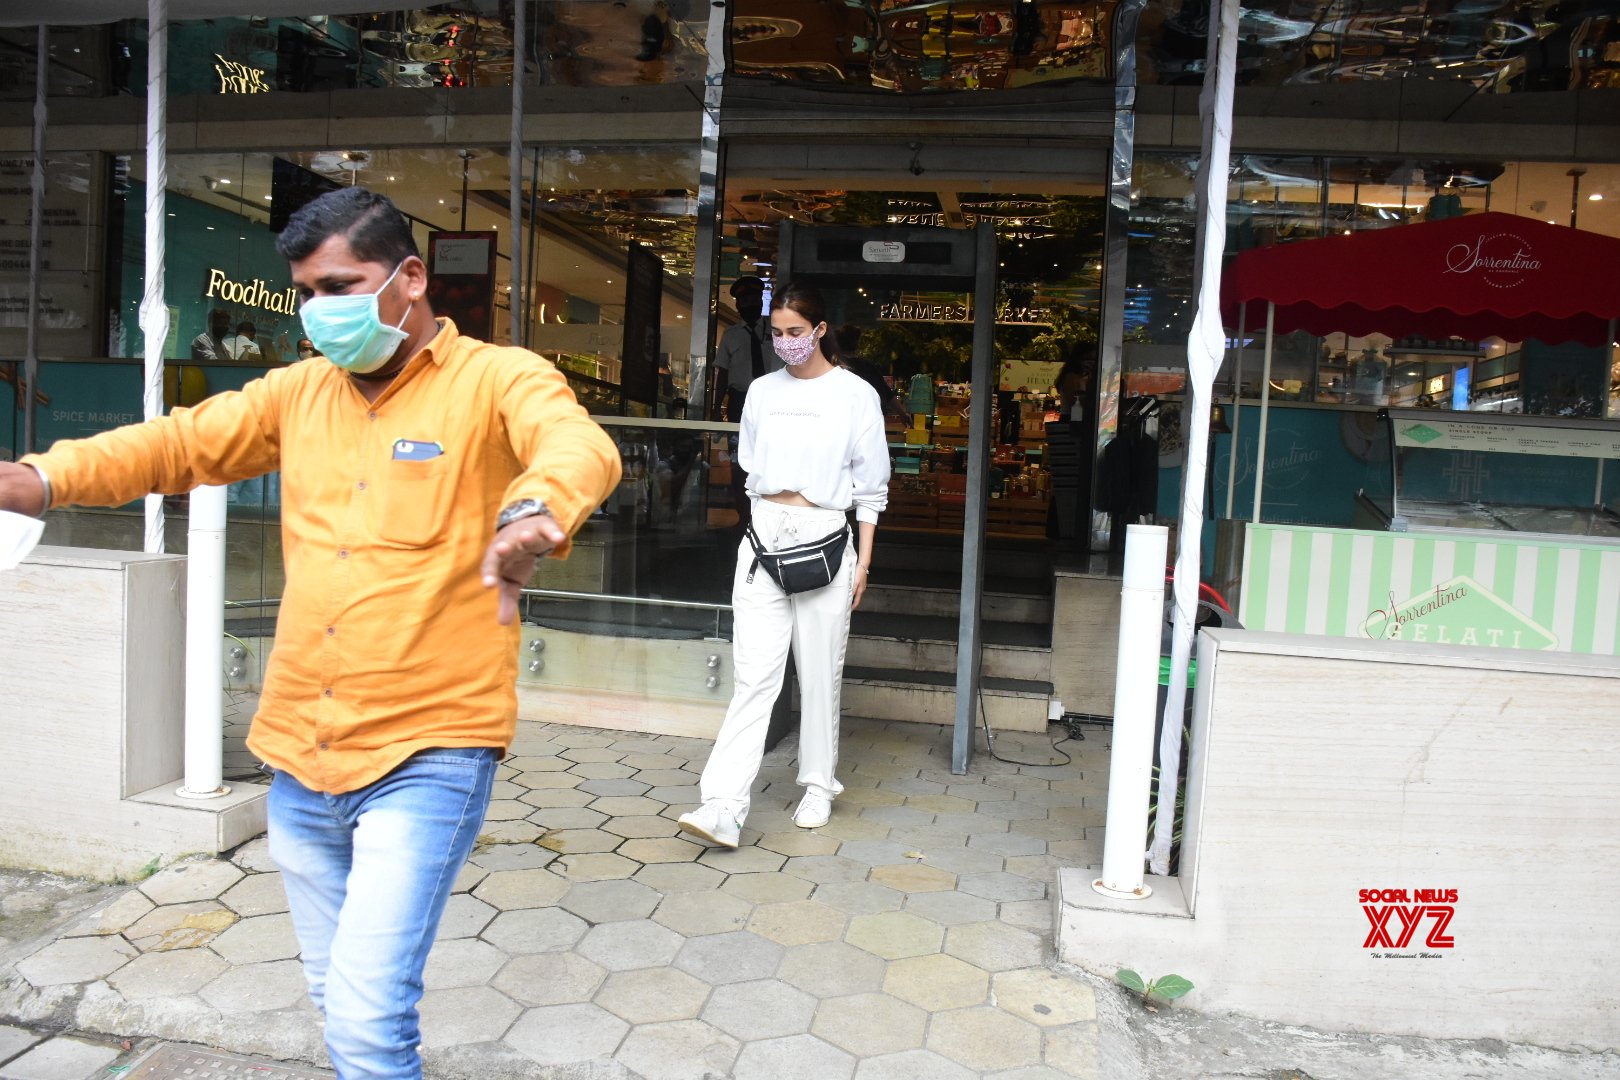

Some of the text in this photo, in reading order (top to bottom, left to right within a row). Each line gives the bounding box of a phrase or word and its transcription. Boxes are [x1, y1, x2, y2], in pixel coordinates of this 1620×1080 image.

[1441, 234, 1542, 274] Sorrentina
[206, 268, 297, 315] Foodhall
[880, 303, 967, 321] FARMERS
[53, 410, 136, 425] SPICE MARKET
[1214, 437, 1321, 491] Sorentina
[1365, 583, 1468, 641] Sorrentina
[1386, 622, 1523, 649] GELATI
